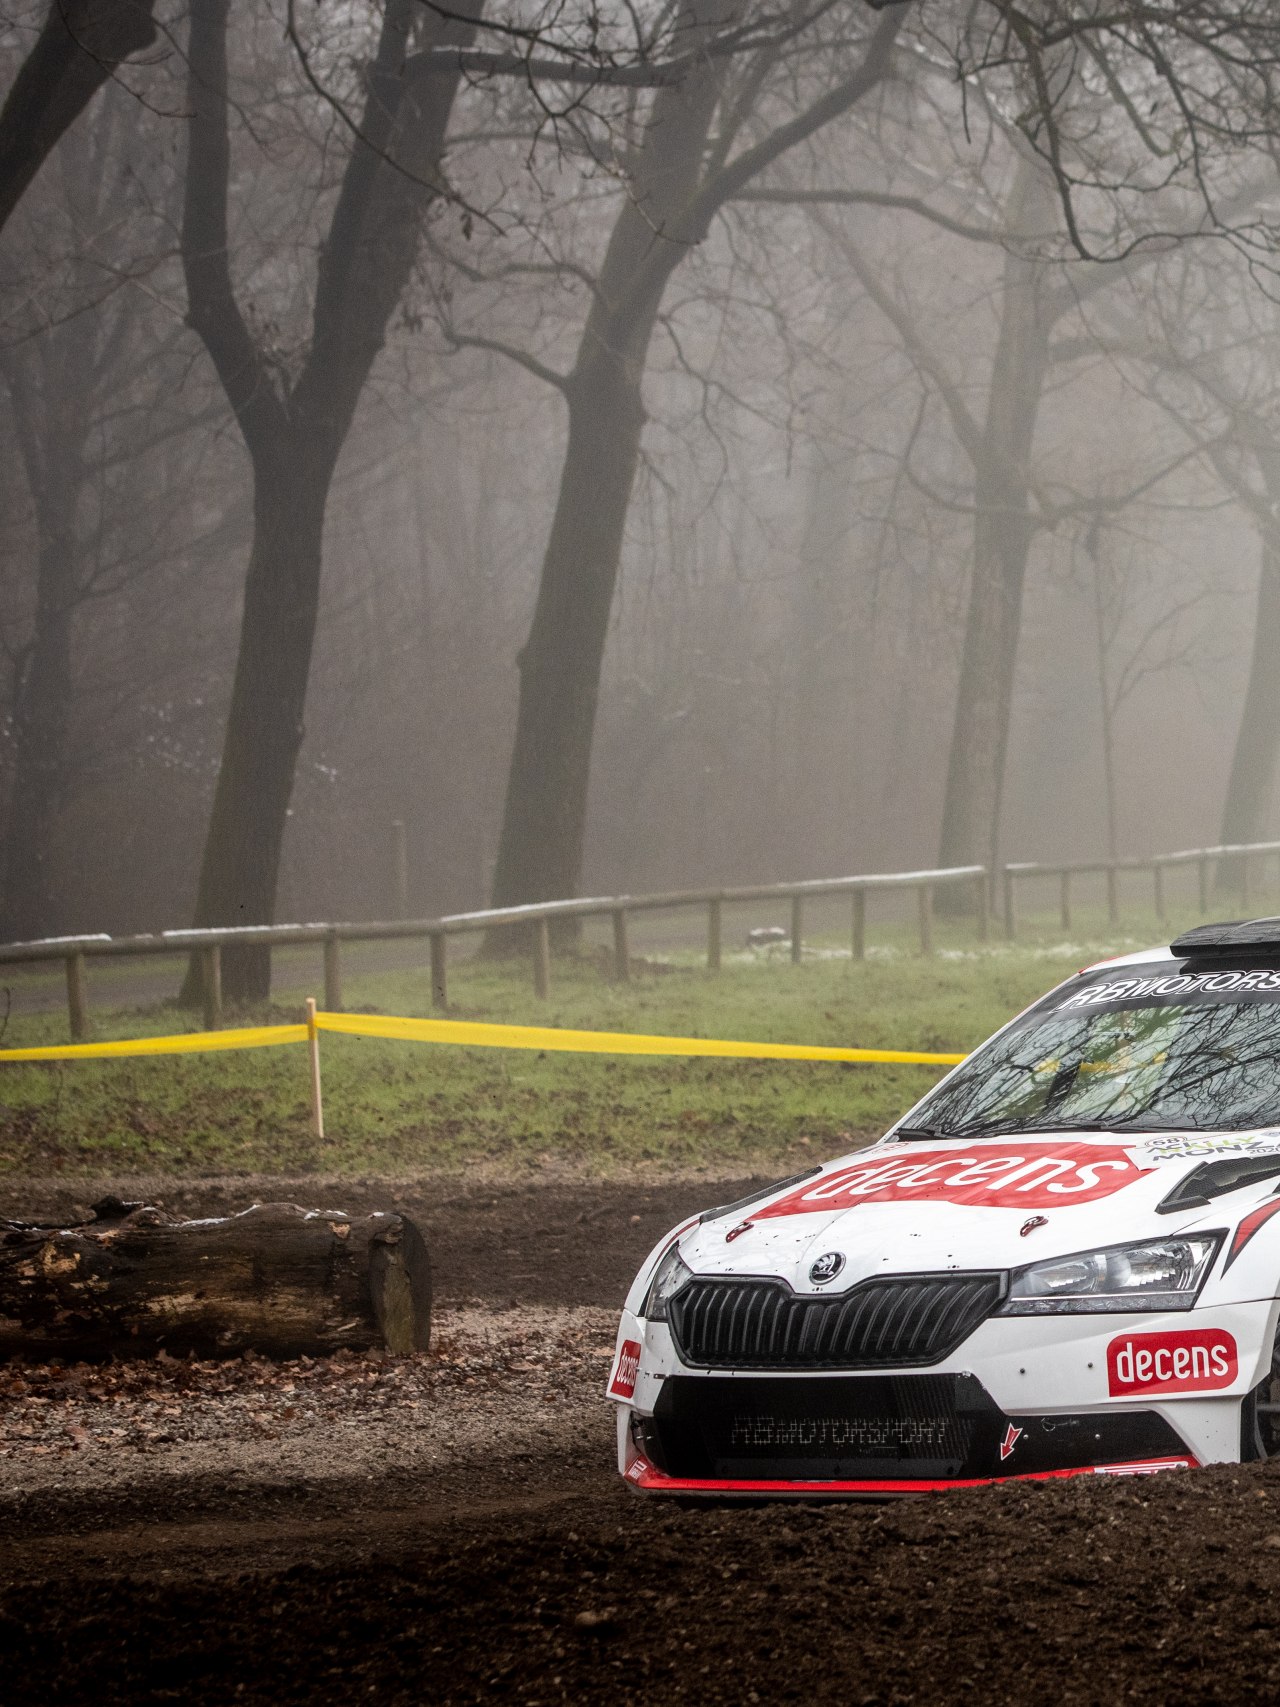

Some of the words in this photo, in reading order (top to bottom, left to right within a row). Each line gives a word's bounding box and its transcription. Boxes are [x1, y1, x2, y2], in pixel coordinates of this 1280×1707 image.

[1152, 1137, 1182, 1146] 58
[801, 1143, 1130, 1200] decens
[1116, 1342, 1229, 1383] decens
